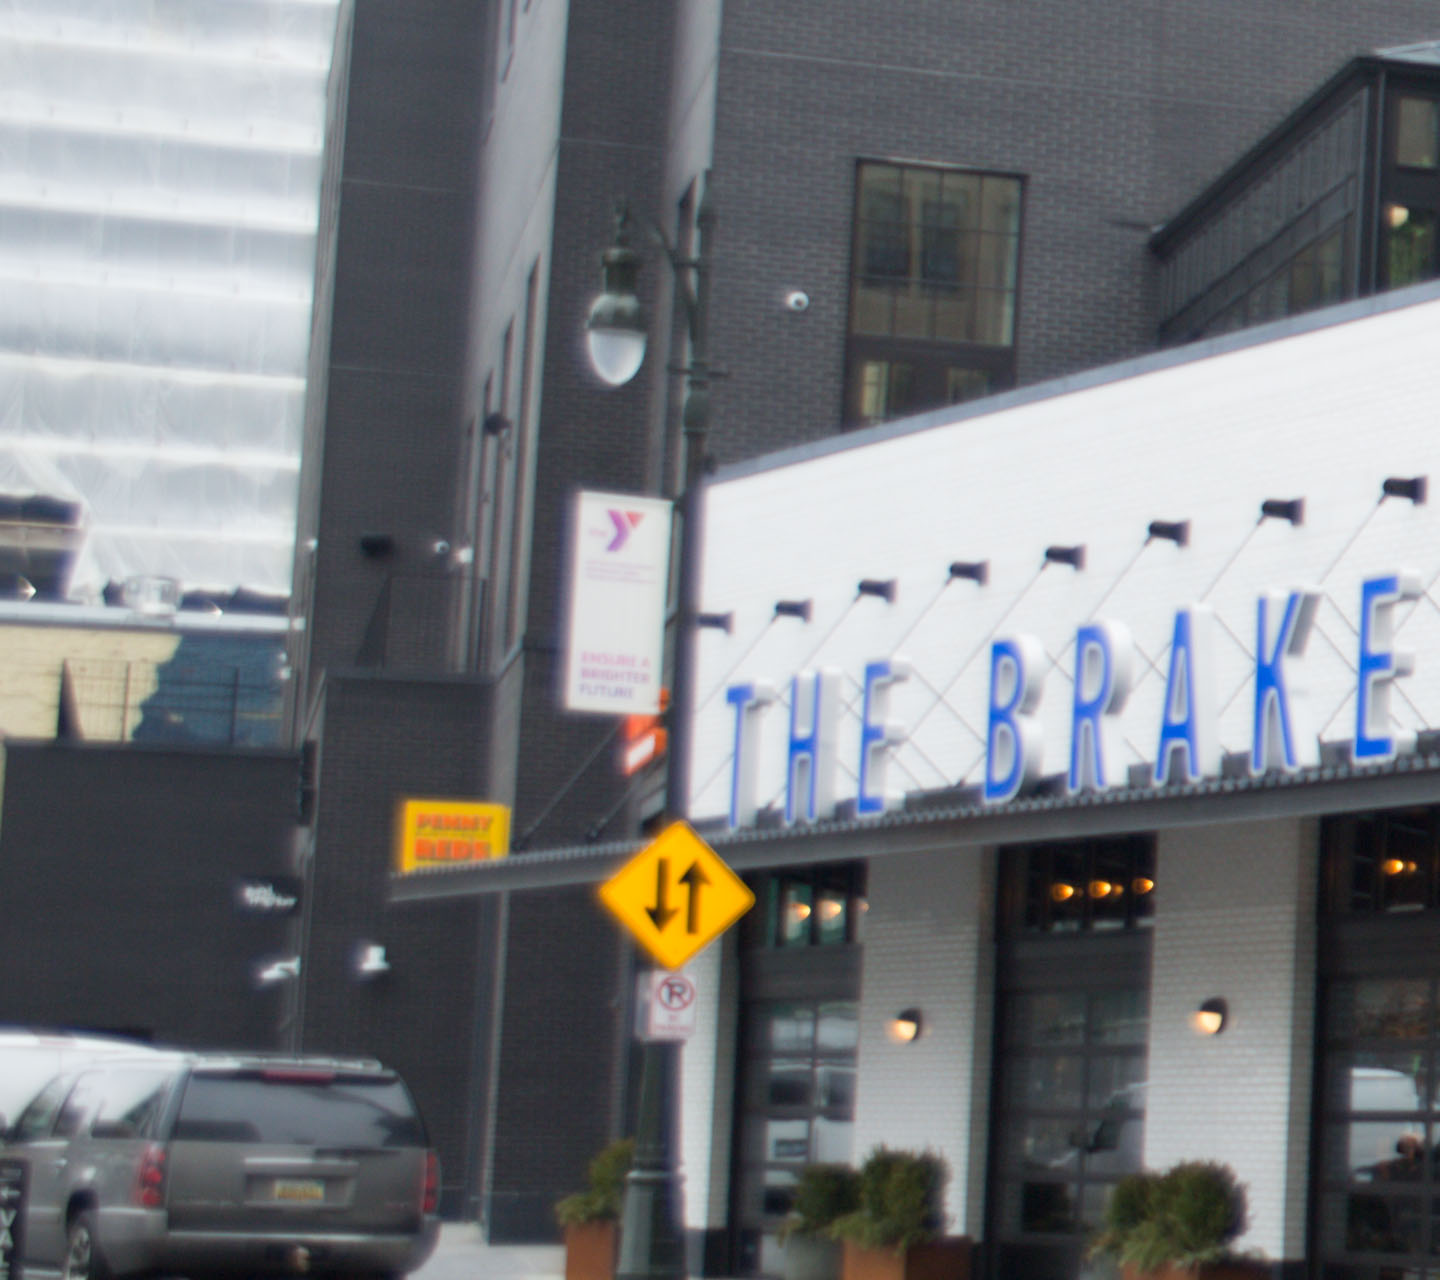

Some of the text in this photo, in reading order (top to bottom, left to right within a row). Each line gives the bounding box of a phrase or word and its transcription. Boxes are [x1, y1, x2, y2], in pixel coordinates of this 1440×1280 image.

[580, 667, 651, 685] BRIGHTER
[578, 683, 634, 700] FUTURE
[725, 659, 893, 830] THE
